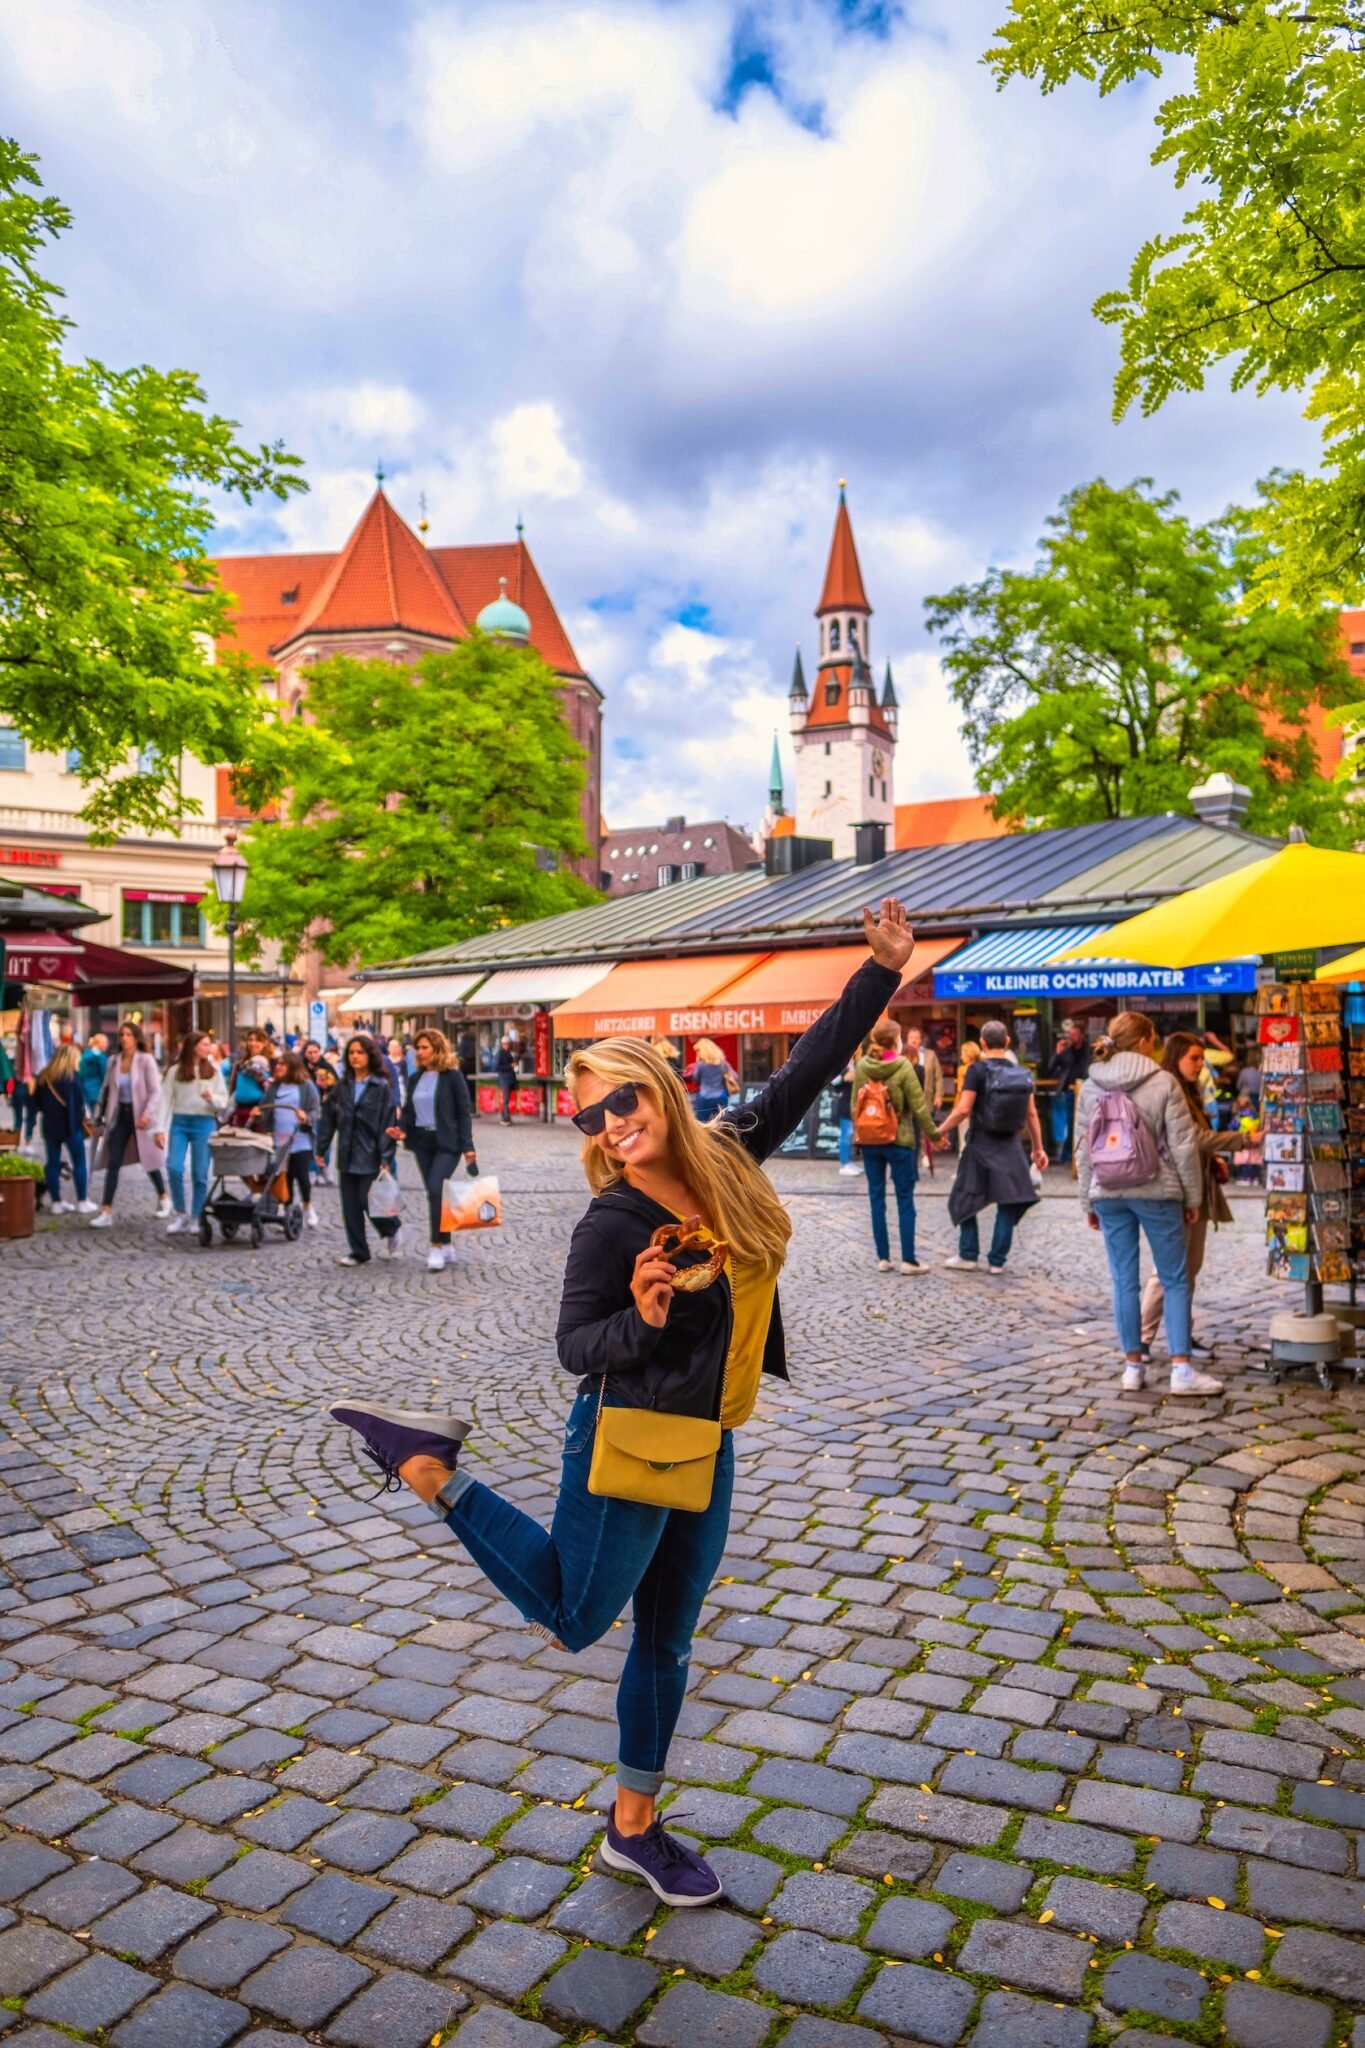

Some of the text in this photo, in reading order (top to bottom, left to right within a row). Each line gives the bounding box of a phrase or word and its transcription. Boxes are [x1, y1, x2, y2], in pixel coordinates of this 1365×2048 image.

[985, 975, 1049, 991] KLEINER
[1052, 970, 1185, 989] OCHS'NBRATER
[593, 1015, 656, 1033] METZGEREI
[669, 1008, 765, 1031] EISENREICH
